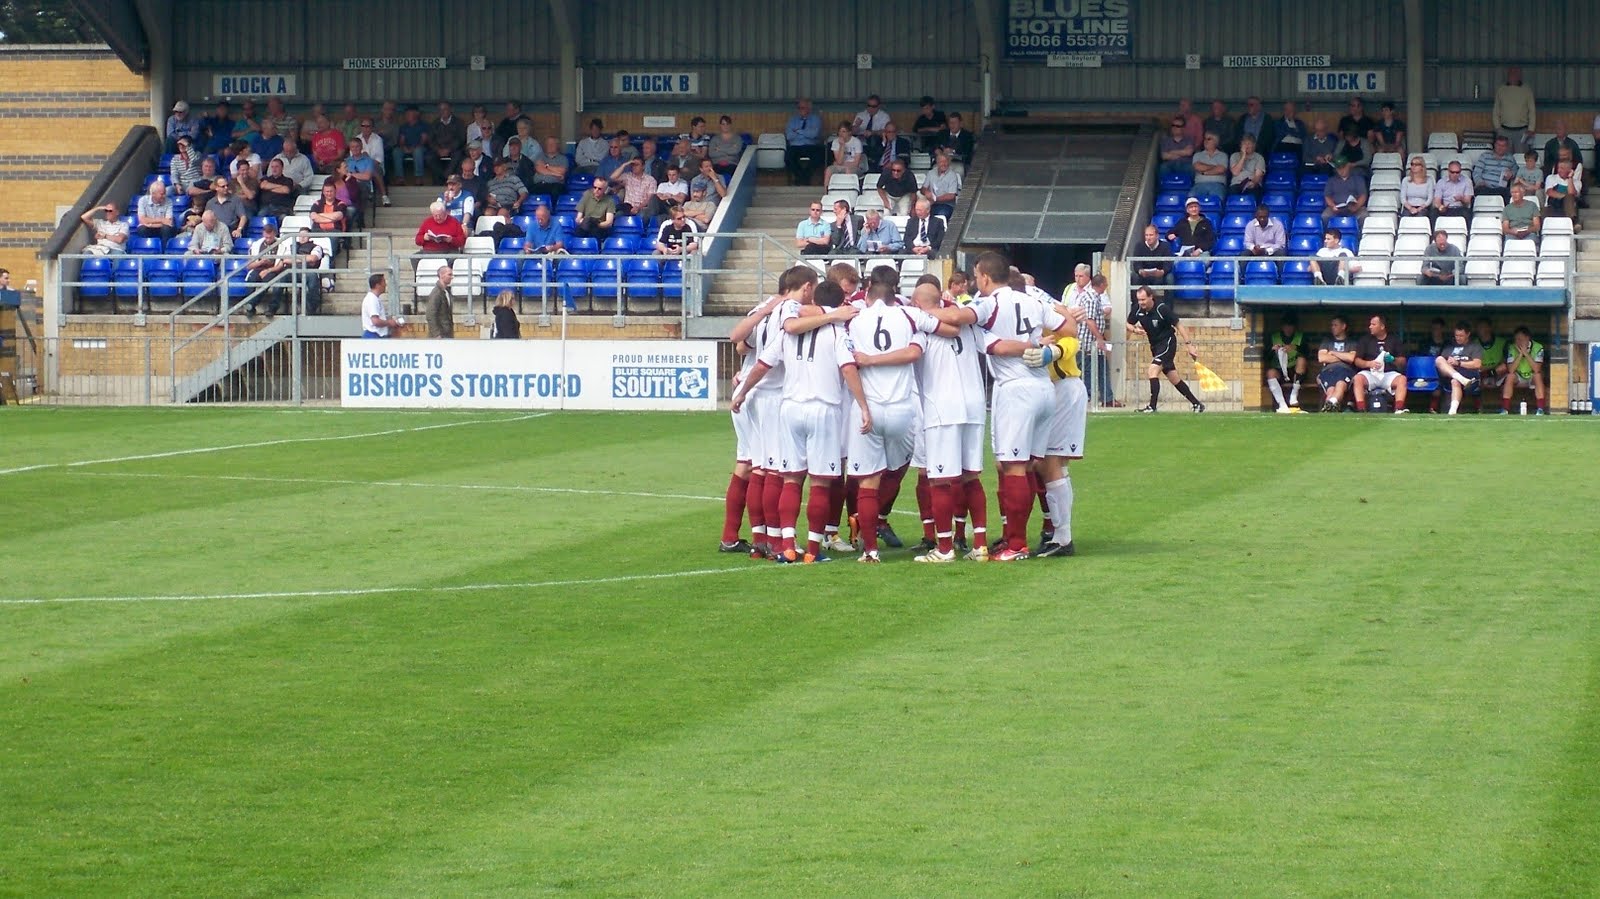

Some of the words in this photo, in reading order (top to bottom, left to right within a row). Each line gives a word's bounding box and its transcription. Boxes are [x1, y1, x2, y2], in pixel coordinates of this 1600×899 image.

[1009, 0, 1128, 18] BLUES
[1009, 20, 1128, 34] HOTLINE
[1010, 35, 1060, 47] 09066
[1066, 35, 1127, 47] 555873
[349, 59, 376, 69] HOME
[379, 58, 440, 68] SUPPORTERS
[1229, 56, 1257, 67] HOME
[1260, 55, 1325, 66] SUPPORTERS
[221, 77, 270, 94] BLOCK
[277, 77, 287, 93] A
[622, 75, 673, 92] BLOCK
[679, 75, 689, 92] B
[1307, 73, 1359, 90] BLOCK
[1366, 73, 1376, 90] C
[1015, 302, 1036, 336] 4
[873, 316, 892, 351] 6
[347, 353, 419, 369] WELCOME
[425, 353, 443, 369] TO
[612, 354, 643, 363] PROUD
[647, 354, 693, 364] MEMBERS
[697, 355, 709, 364] OF
[615, 368, 639, 376] BLUE
[640, 368, 677, 376] SQUARE
[349, 373, 443, 397] BISHOPS
[450, 373, 582, 398] STORTFORD
[614, 376, 677, 397] SOUTH
